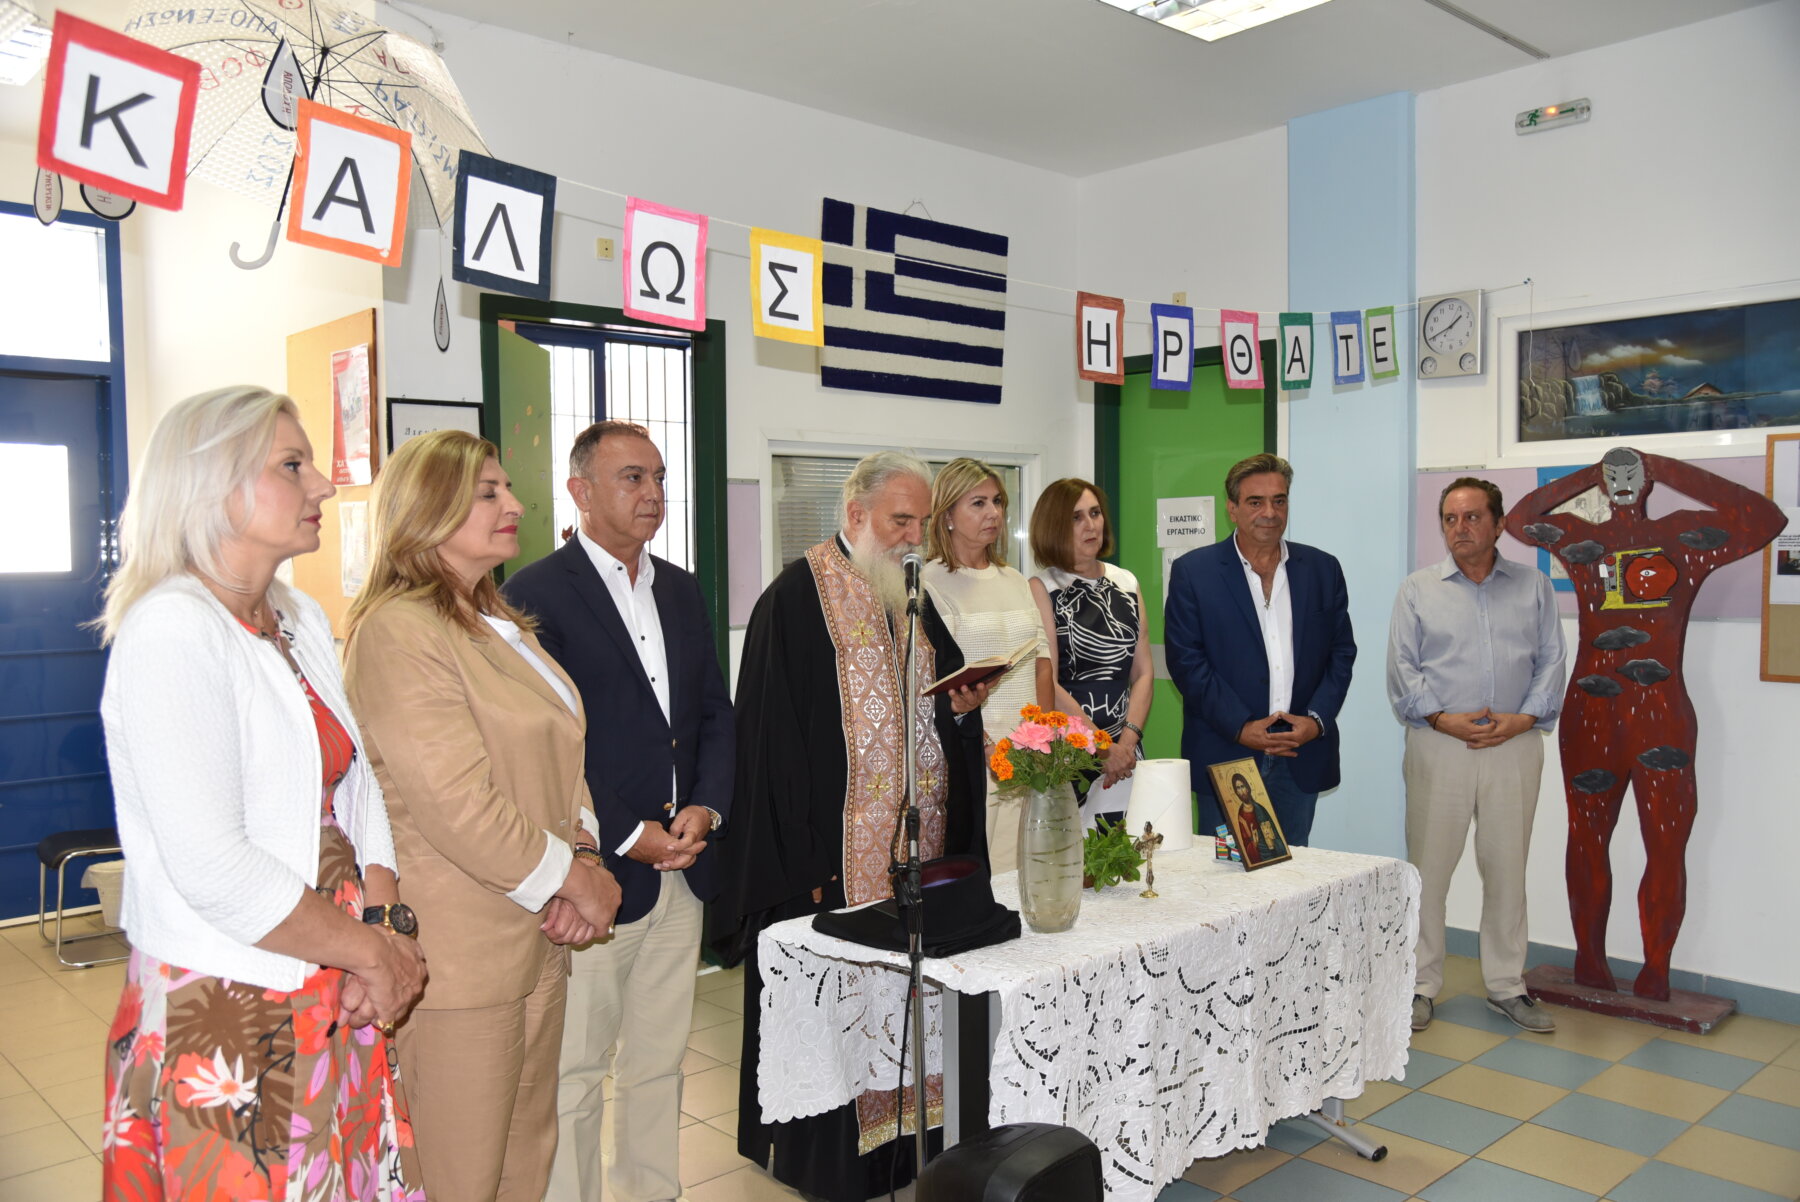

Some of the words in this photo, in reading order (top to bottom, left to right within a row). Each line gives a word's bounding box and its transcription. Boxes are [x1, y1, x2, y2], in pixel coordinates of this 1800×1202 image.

[1087, 320, 1388, 375] ΗΡΘΑΤΕ
[1169, 515, 1203, 523] ΕΙΚΑΣΤΙΚΟ
[1167, 527, 1206, 535] ΕΡΓΑΣΤΗΡΙΟ
